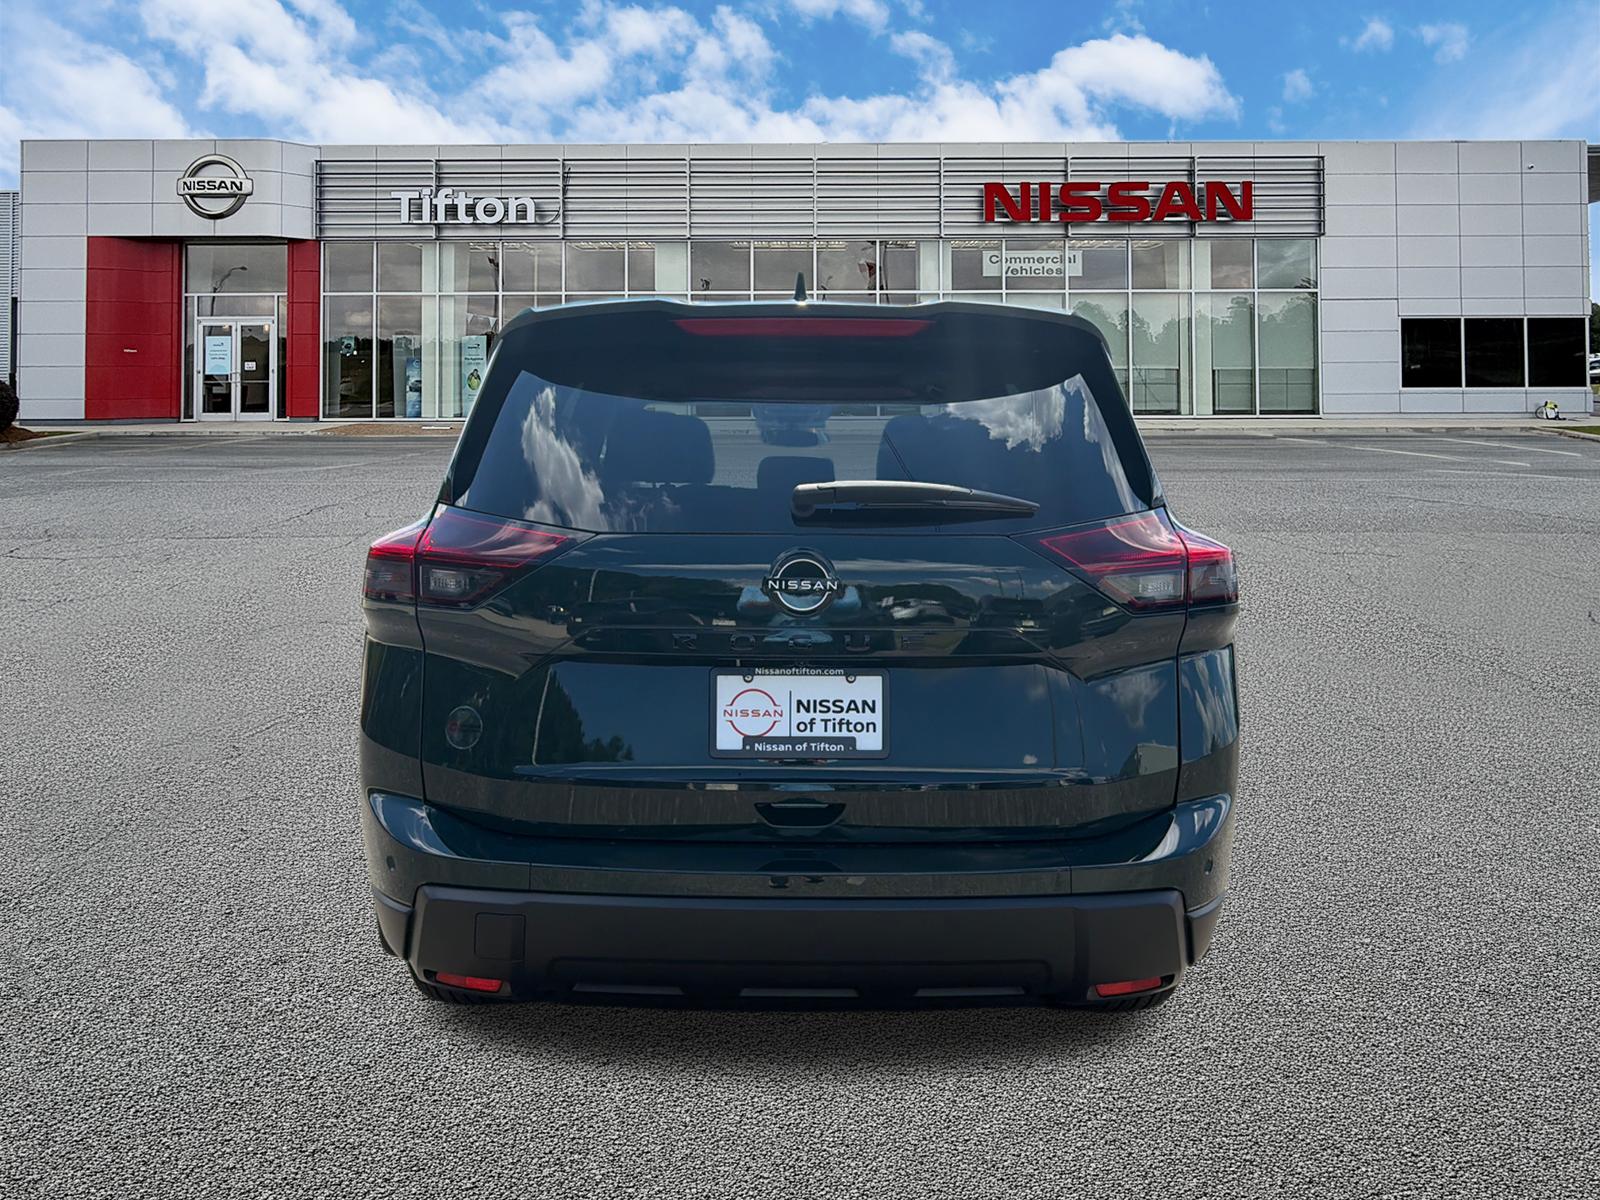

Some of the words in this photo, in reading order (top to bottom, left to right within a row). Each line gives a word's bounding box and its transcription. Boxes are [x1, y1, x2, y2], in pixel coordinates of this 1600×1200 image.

[182, 180, 243, 191] NISSAN
[391, 189, 535, 224] Tifton
[984, 181, 1253, 222] NISSAN
[768, 580, 838, 591] NISSAN
[755, 667, 844, 676] Nissanoftifton.com
[795, 699, 876, 714] NISSAN
[723, 708, 783, 718] NISSAN
[796, 718, 816, 733] of
[820, 718, 877, 733] Tifton
[754, 742, 792, 752] Nissan
[795, 742, 807, 752] of
[810, 742, 844, 752] Tifton
